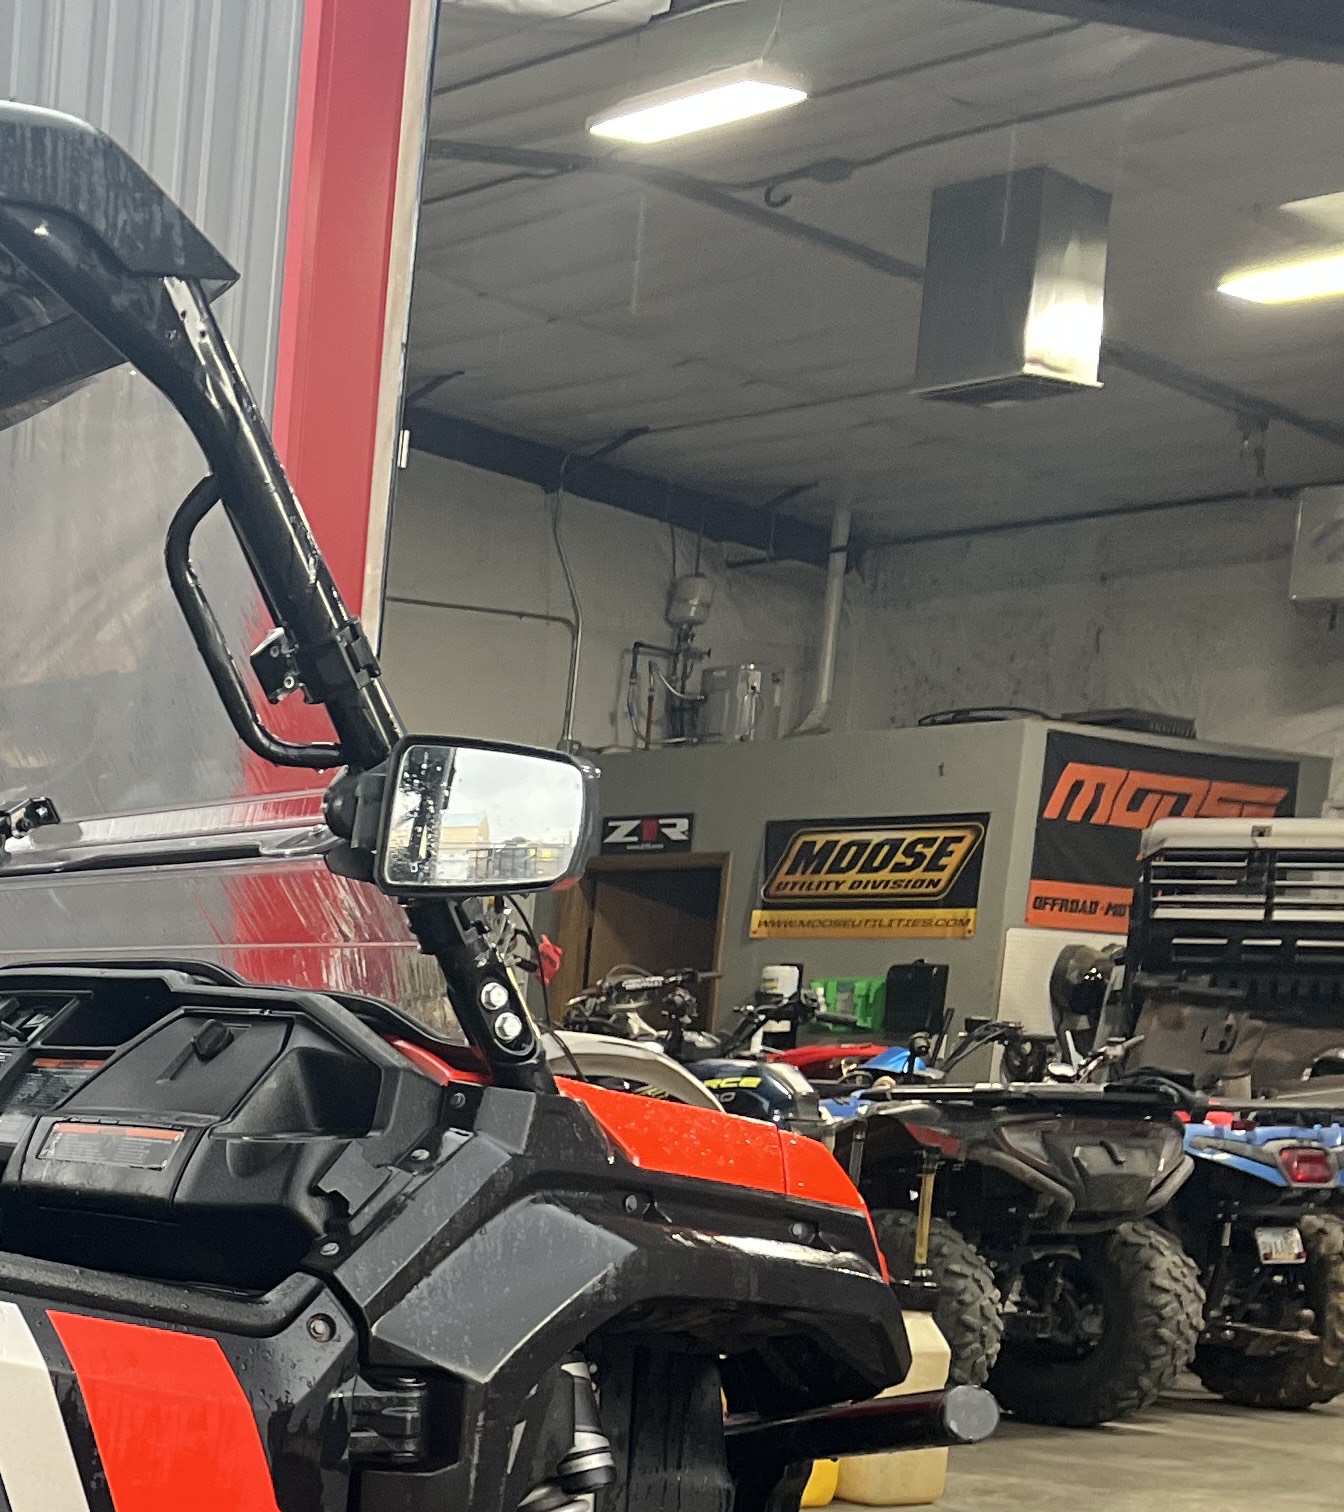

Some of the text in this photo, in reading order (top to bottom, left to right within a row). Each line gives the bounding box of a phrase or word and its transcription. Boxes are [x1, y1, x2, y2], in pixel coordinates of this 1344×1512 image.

[785, 836, 966, 876] MOOSE
[776, 877, 942, 893] UTILITY DIVISION
